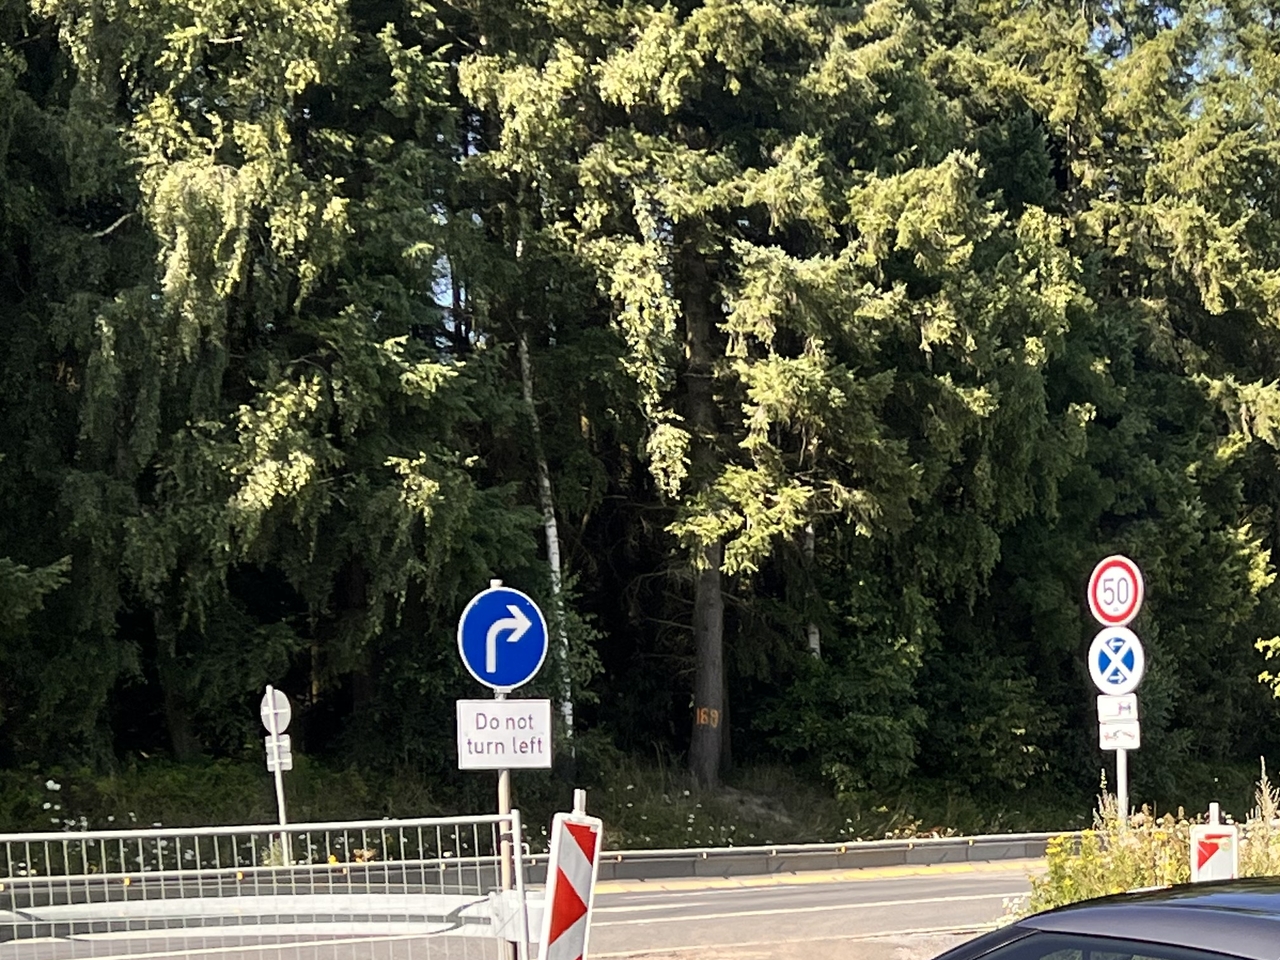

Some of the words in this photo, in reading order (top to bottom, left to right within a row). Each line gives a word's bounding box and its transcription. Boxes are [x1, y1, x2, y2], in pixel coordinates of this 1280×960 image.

[1103, 577, 1129, 605] 50
[475, 712, 500, 730] Do
[505, 713, 534, 730] not
[467, 738, 505, 755] turn
[513, 736, 543, 754] left
